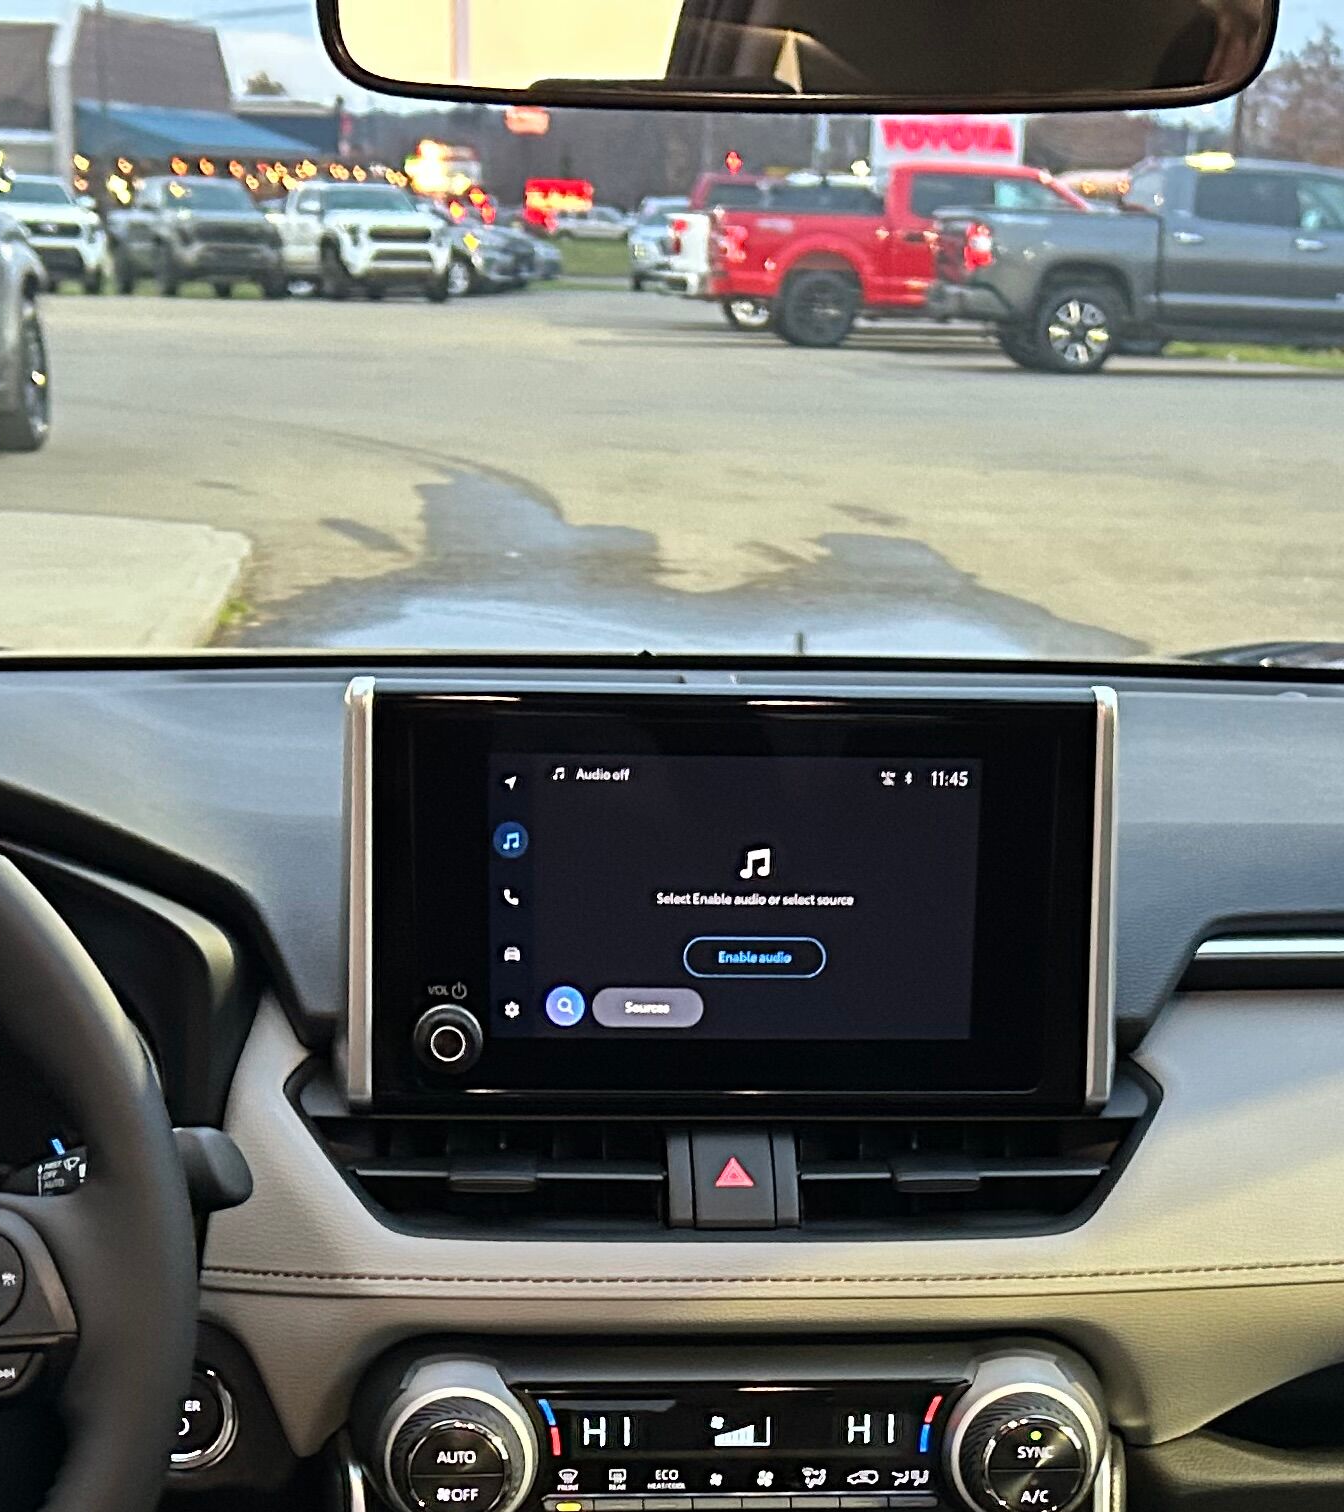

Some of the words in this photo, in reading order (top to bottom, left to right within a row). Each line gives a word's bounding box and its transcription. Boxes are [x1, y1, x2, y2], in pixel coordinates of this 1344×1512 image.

[881, 119, 1014, 153] TOYOTA
[576, 767, 610, 782] Audio
[612, 767, 630, 782] off
[930, 771, 969, 787] 11:45
[656, 892, 692, 906] Select
[693, 892, 732, 906] Enable
[734, 892, 767, 906] audio
[768, 895, 781, 906] or
[782, 892, 815, 907] select
[817, 895, 854, 907] source
[718, 951, 757, 964] Enable
[759, 951, 792, 964] audio
[624, 1002, 670, 1015] Sources
[583, 1416, 631, 1447] HI
[848, 1413, 896, 1444] HI
[436, 1451, 477, 1465] AUTO
[1017, 1446, 1054, 1460] SYNC
[655, 1469, 679, 1480] ECO
[451, 1488, 478, 1501] OFF
[1020, 1490, 1049, 1504] A/C
